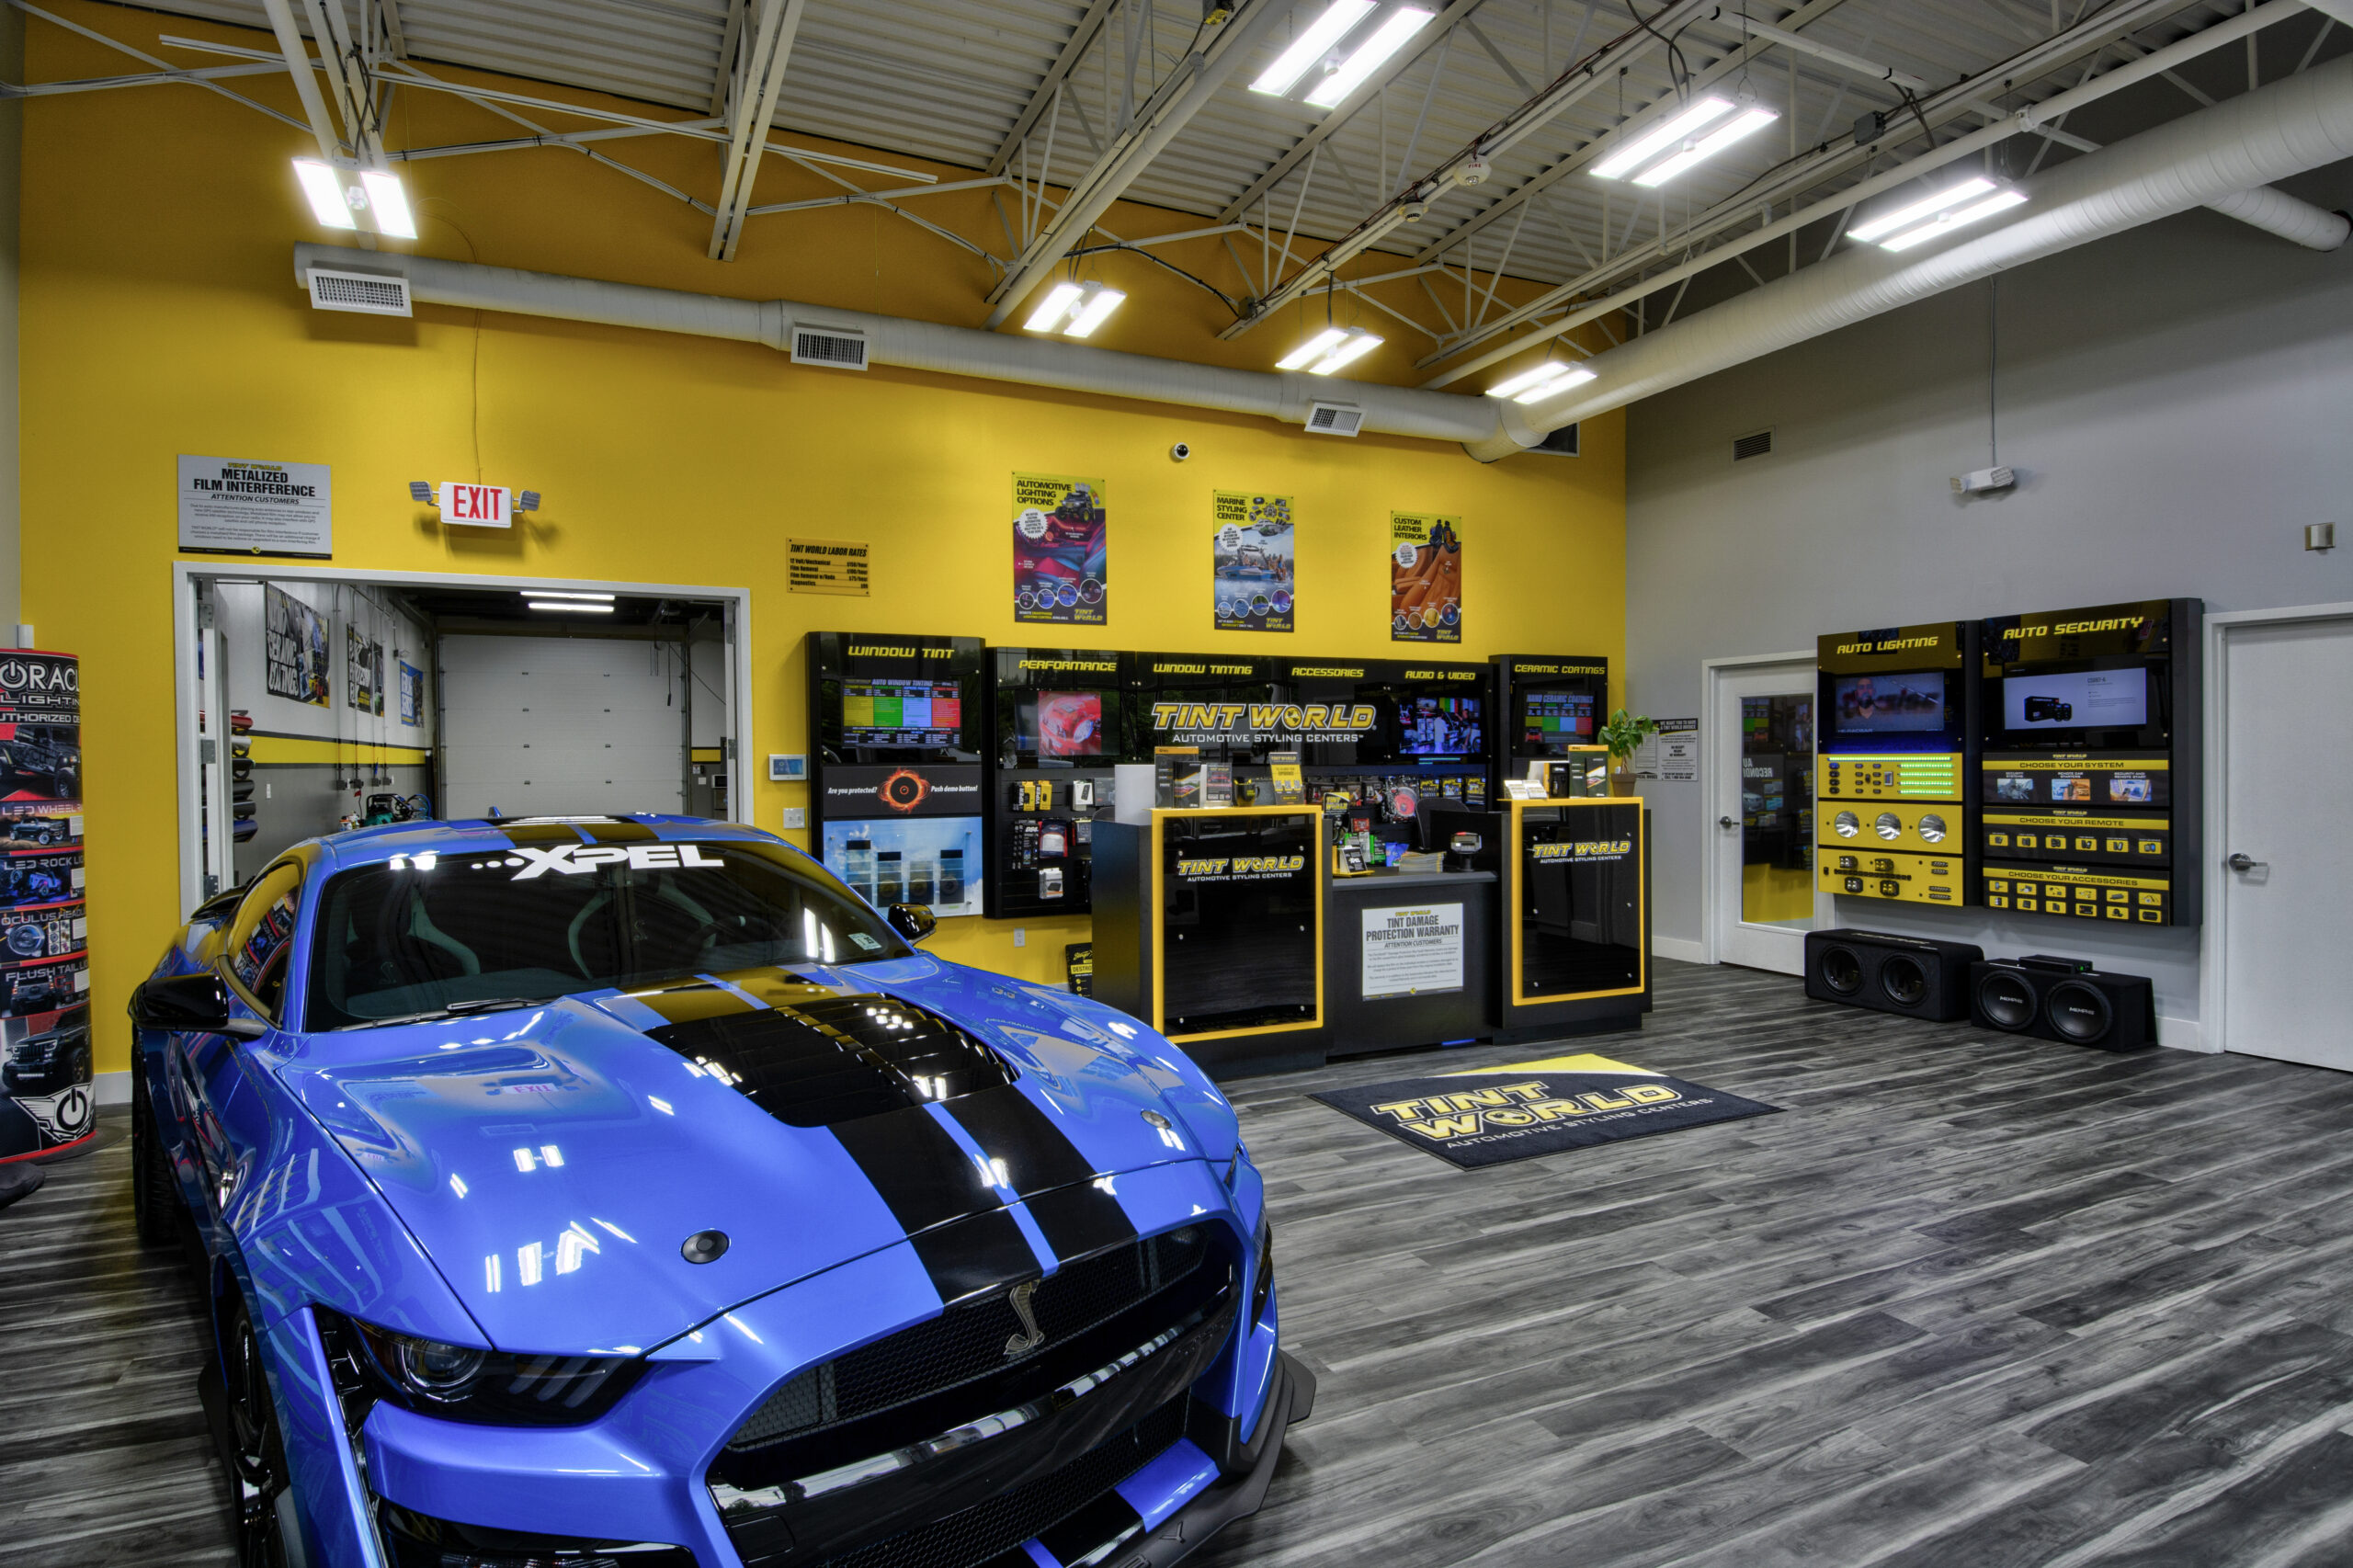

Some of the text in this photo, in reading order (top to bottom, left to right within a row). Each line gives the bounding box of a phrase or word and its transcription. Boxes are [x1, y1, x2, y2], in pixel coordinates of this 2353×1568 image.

[222, 469, 288, 483] METALIZED
[194, 479, 315, 497] FILM INTERFERENCE
[1017, 480, 1072, 491] AUTOMOTIVE
[1017, 488, 1057, 498] LIGHTING
[211, 494, 300, 505] ATTENTION CUSTOMERS
[454, 485, 502, 520] EXIT
[1017, 496, 1054, 506] OPTIONS
[1217, 497, 1245, 506] MARINE
[1217, 505, 1247, 514] STYLING
[1217, 512, 1245, 521] CENTER
[1394, 517, 1422, 526] CUSTOM
[1394, 532, 1427, 540] INTERIORS
[790, 544, 868, 557] TINT WORLD LABOR RATES
[2003, 617, 2144, 640] AUTO SECURITY
[1836, 636, 1939, 654] AUTO LIGHTING
[848, 646, 955, 659] WINDOW TINT
[1018, 660, 1117, 672] PERFORMANCE
[1153, 663, 1253, 675] WINDOW TINTING
[1291, 667, 1365, 677] ACCESSORIES
[1514, 665, 1606, 675] CERAMIC COATINGS
[1404, 670, 1476, 680] AUDIO & VIDEO
[1151, 703, 1377, 730] TINT WORLD
[1172, 733, 1358, 743] AUTOMOTIVE STYLING CENTERS
[847, 786, 878, 795] protected?
[2, 804, 76, 816] LED WHEEL
[1532, 840, 1631, 858] TINT WORLD
[4, 857, 73, 870] LED ROCK
[507, 844, 724, 881] XPEL
[1177, 856, 1304, 876] TINT WORLD
[2008, 871, 2044, 880] CHOOSE
[2072, 876, 2138, 886] ACCESSORIES
[1, 913, 57, 926] OCULUS
[1387, 915, 1438, 928] TINT DAMAGE
[1366, 925, 1459, 941] PROTECTION WARRANTY
[1384, 938, 1442, 949] ATTENTION CUSTOMERS
[6, 963, 79, 983] FLUSH TAIL
[1999, 995, 2023, 1004] MEMPHIS
[2069, 1006, 2095, 1016] MEMPHIS
[1370, 1081, 1550, 1122] TINT
[1397, 1084, 1682, 1141] WORLD
[1446, 1098, 1710, 1150] AUTOMOTIVE STYLING CENTERS
